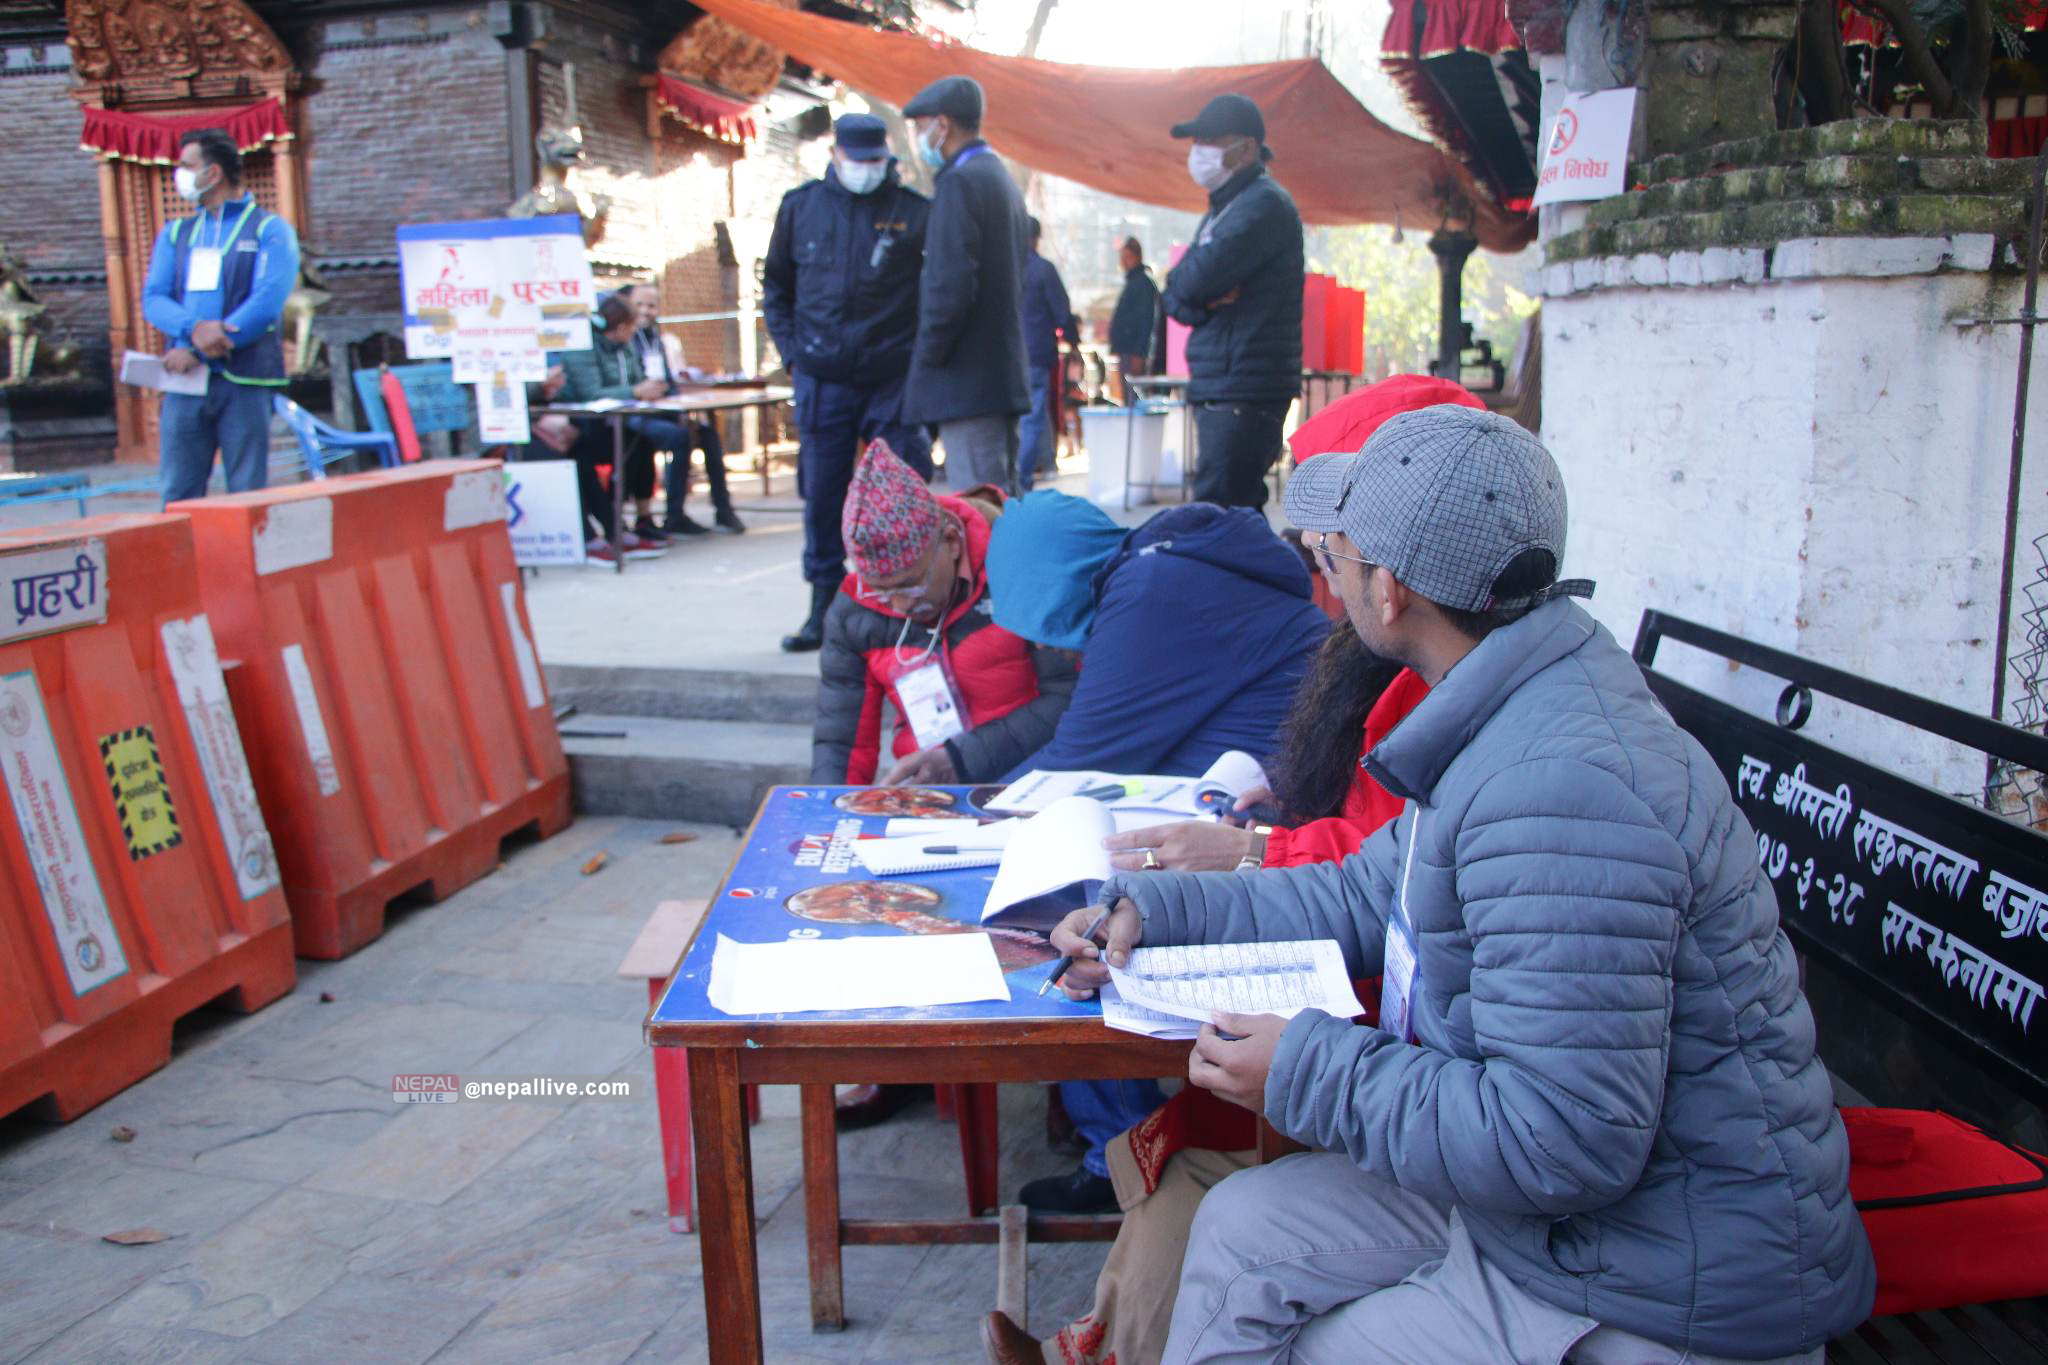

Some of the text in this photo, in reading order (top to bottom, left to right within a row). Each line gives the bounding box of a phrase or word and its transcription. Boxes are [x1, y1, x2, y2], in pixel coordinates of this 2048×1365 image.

[1564, 157, 1609, 180] निषेध
[416, 283, 490, 308] महिला
[512, 279, 582, 304] पुरुष
[12, 554, 98, 625] प्रहरी
[1773, 763, 1851, 840] श्रीमती
[1854, 809, 1979, 901] सकुन्तला
[1882, 901, 2046, 1037] सम्झनामा
